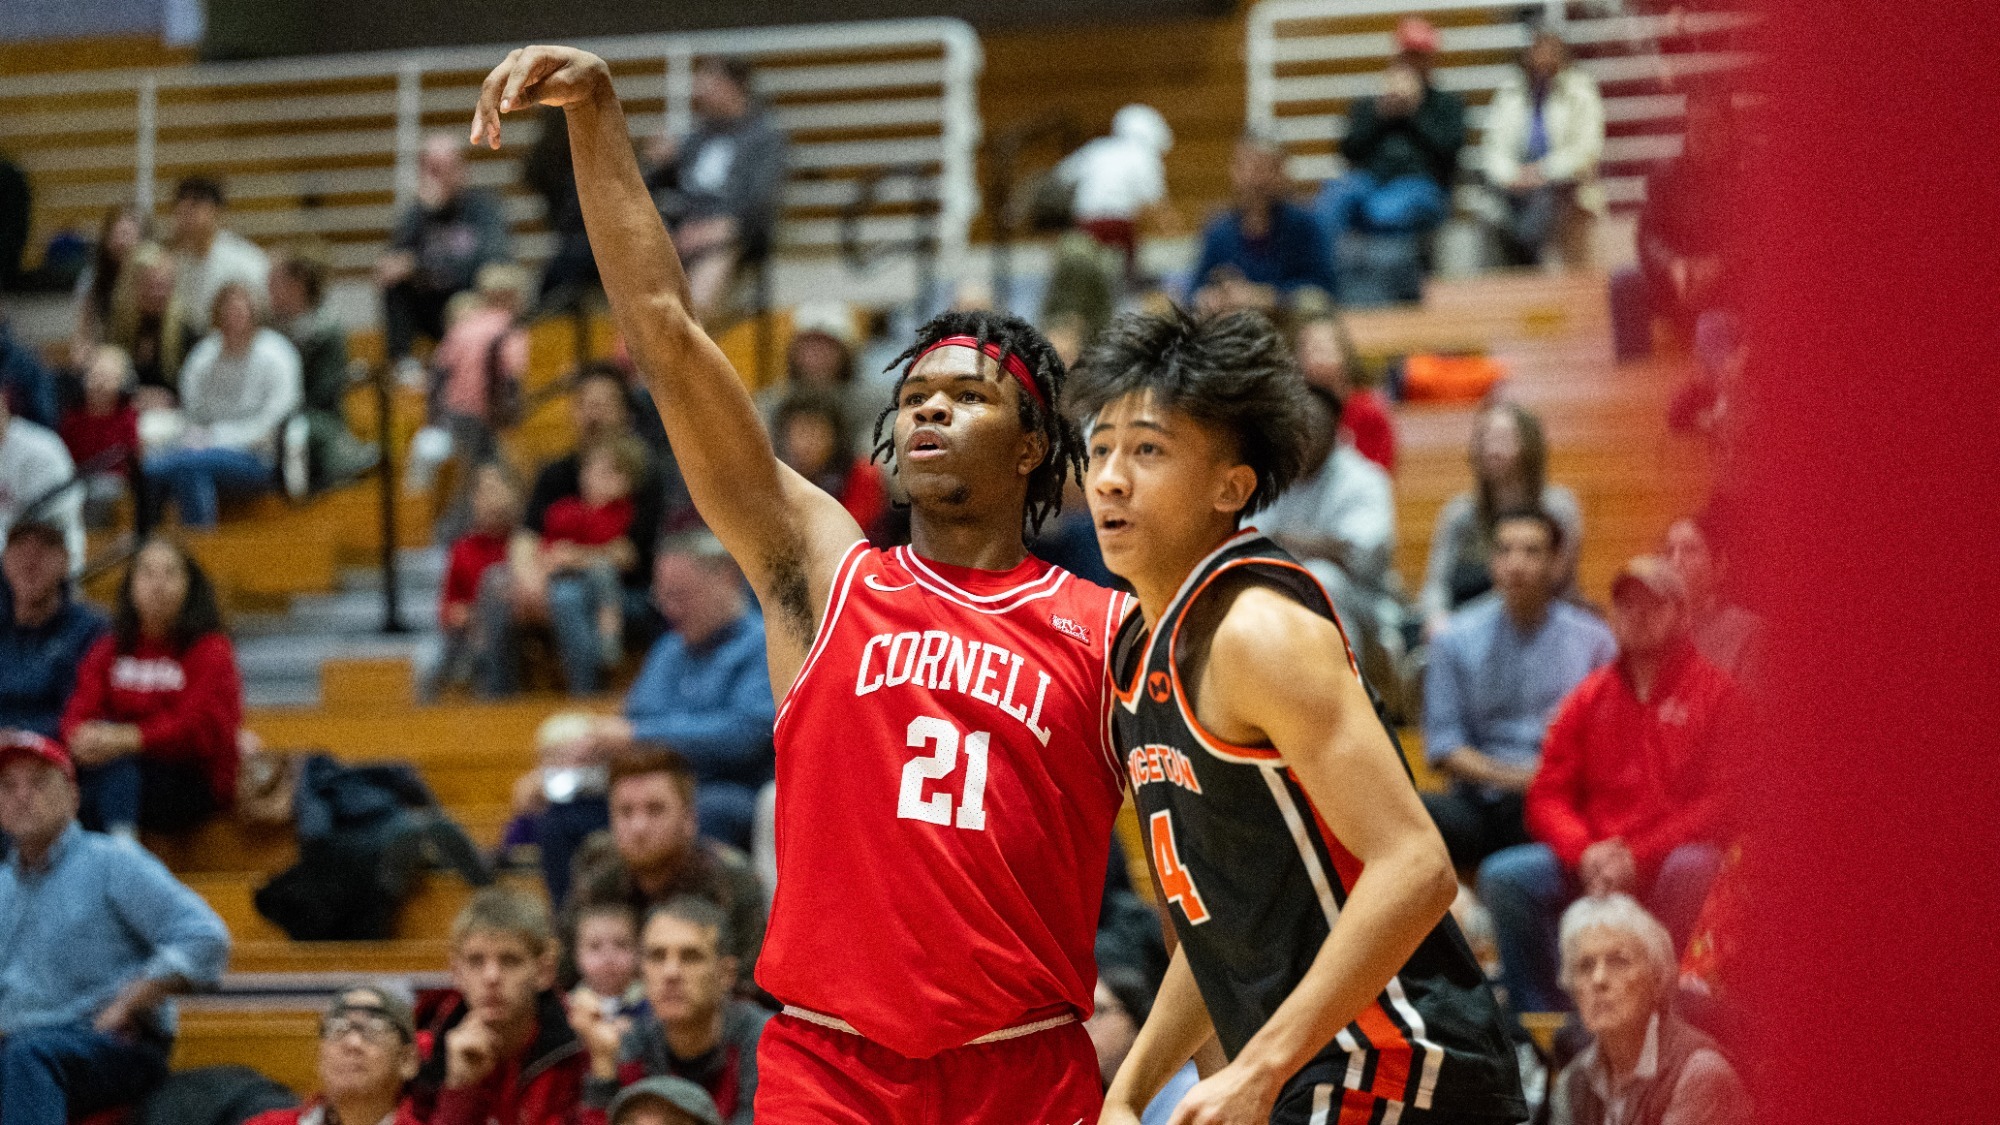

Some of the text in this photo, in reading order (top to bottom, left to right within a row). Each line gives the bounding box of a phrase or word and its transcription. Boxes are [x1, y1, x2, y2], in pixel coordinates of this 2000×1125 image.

[855, 630, 1052, 748] CORNELL
[897, 715, 991, 831] 21
[1127, 743, 1203, 795] NCETON
[1150, 808, 1211, 926] 4
